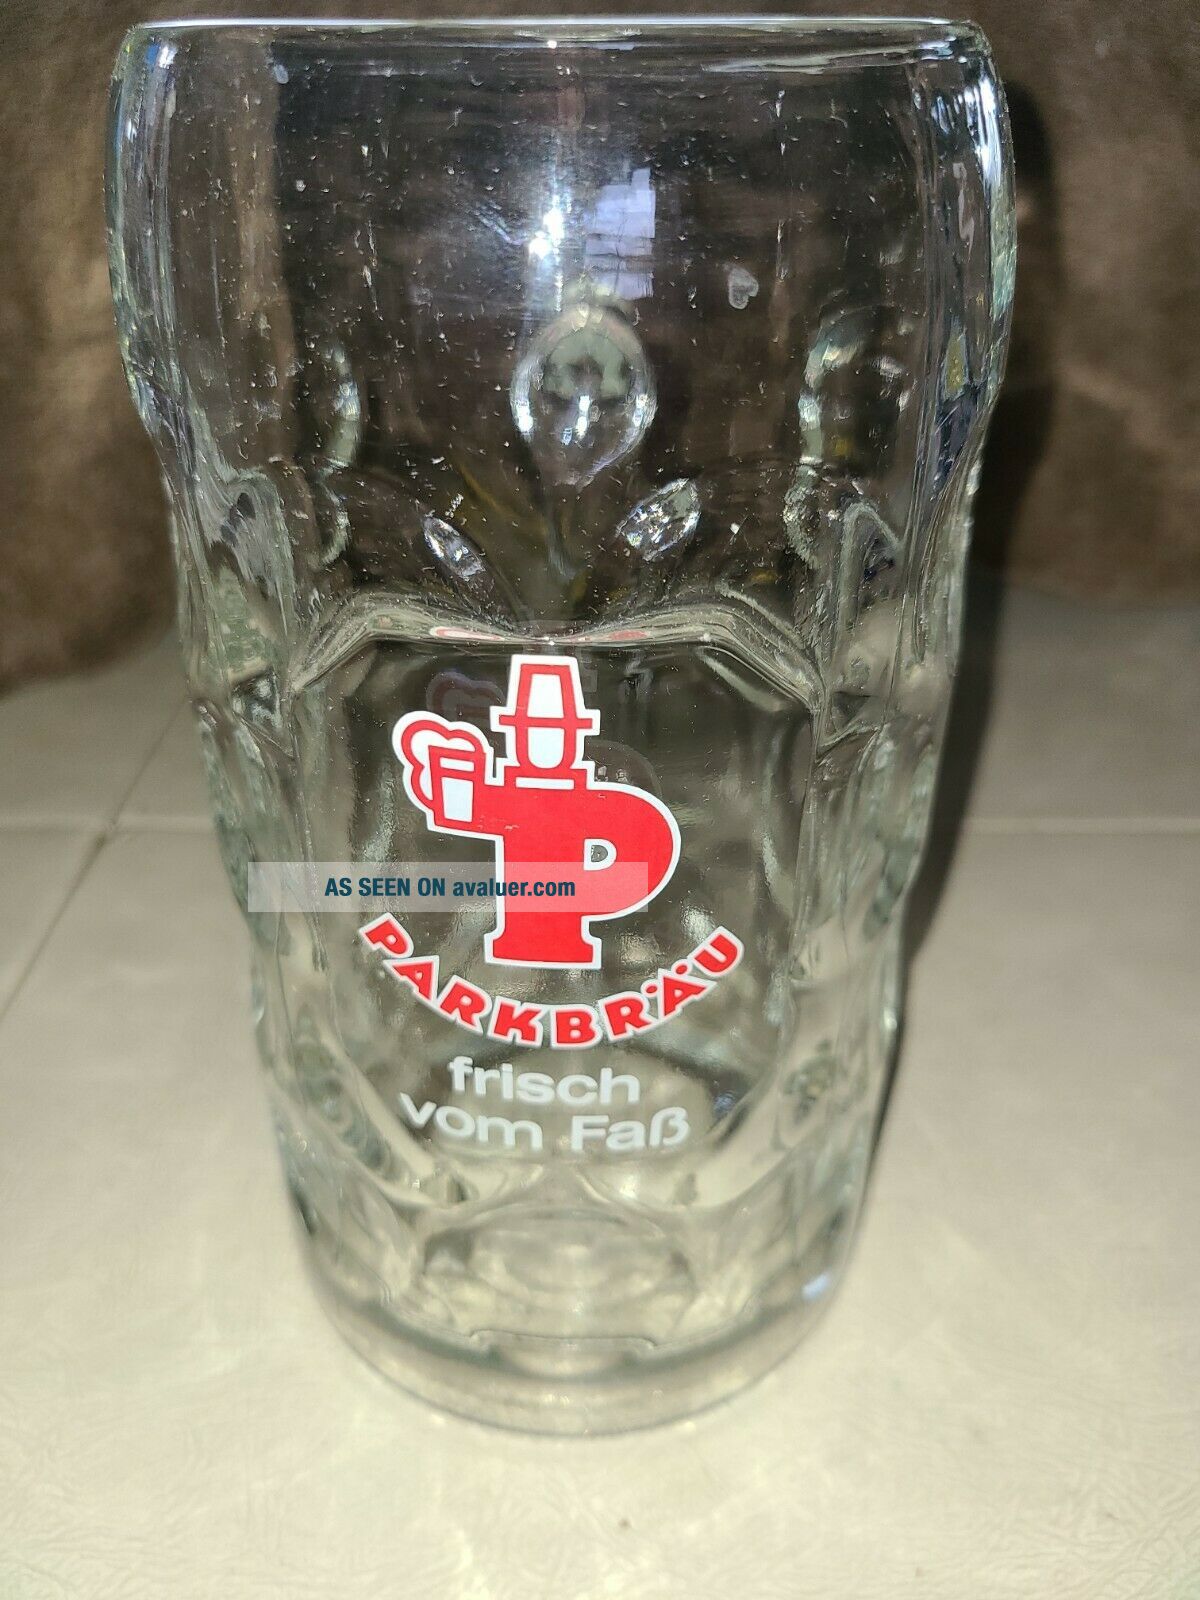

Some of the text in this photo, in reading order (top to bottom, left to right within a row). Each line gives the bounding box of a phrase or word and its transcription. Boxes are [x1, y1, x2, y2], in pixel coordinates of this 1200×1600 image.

[359, 912, 744, 1049] PARKBRÄU
[448, 1056, 640, 1107] frisch
[400, 1092, 690, 1153] vom Faß
